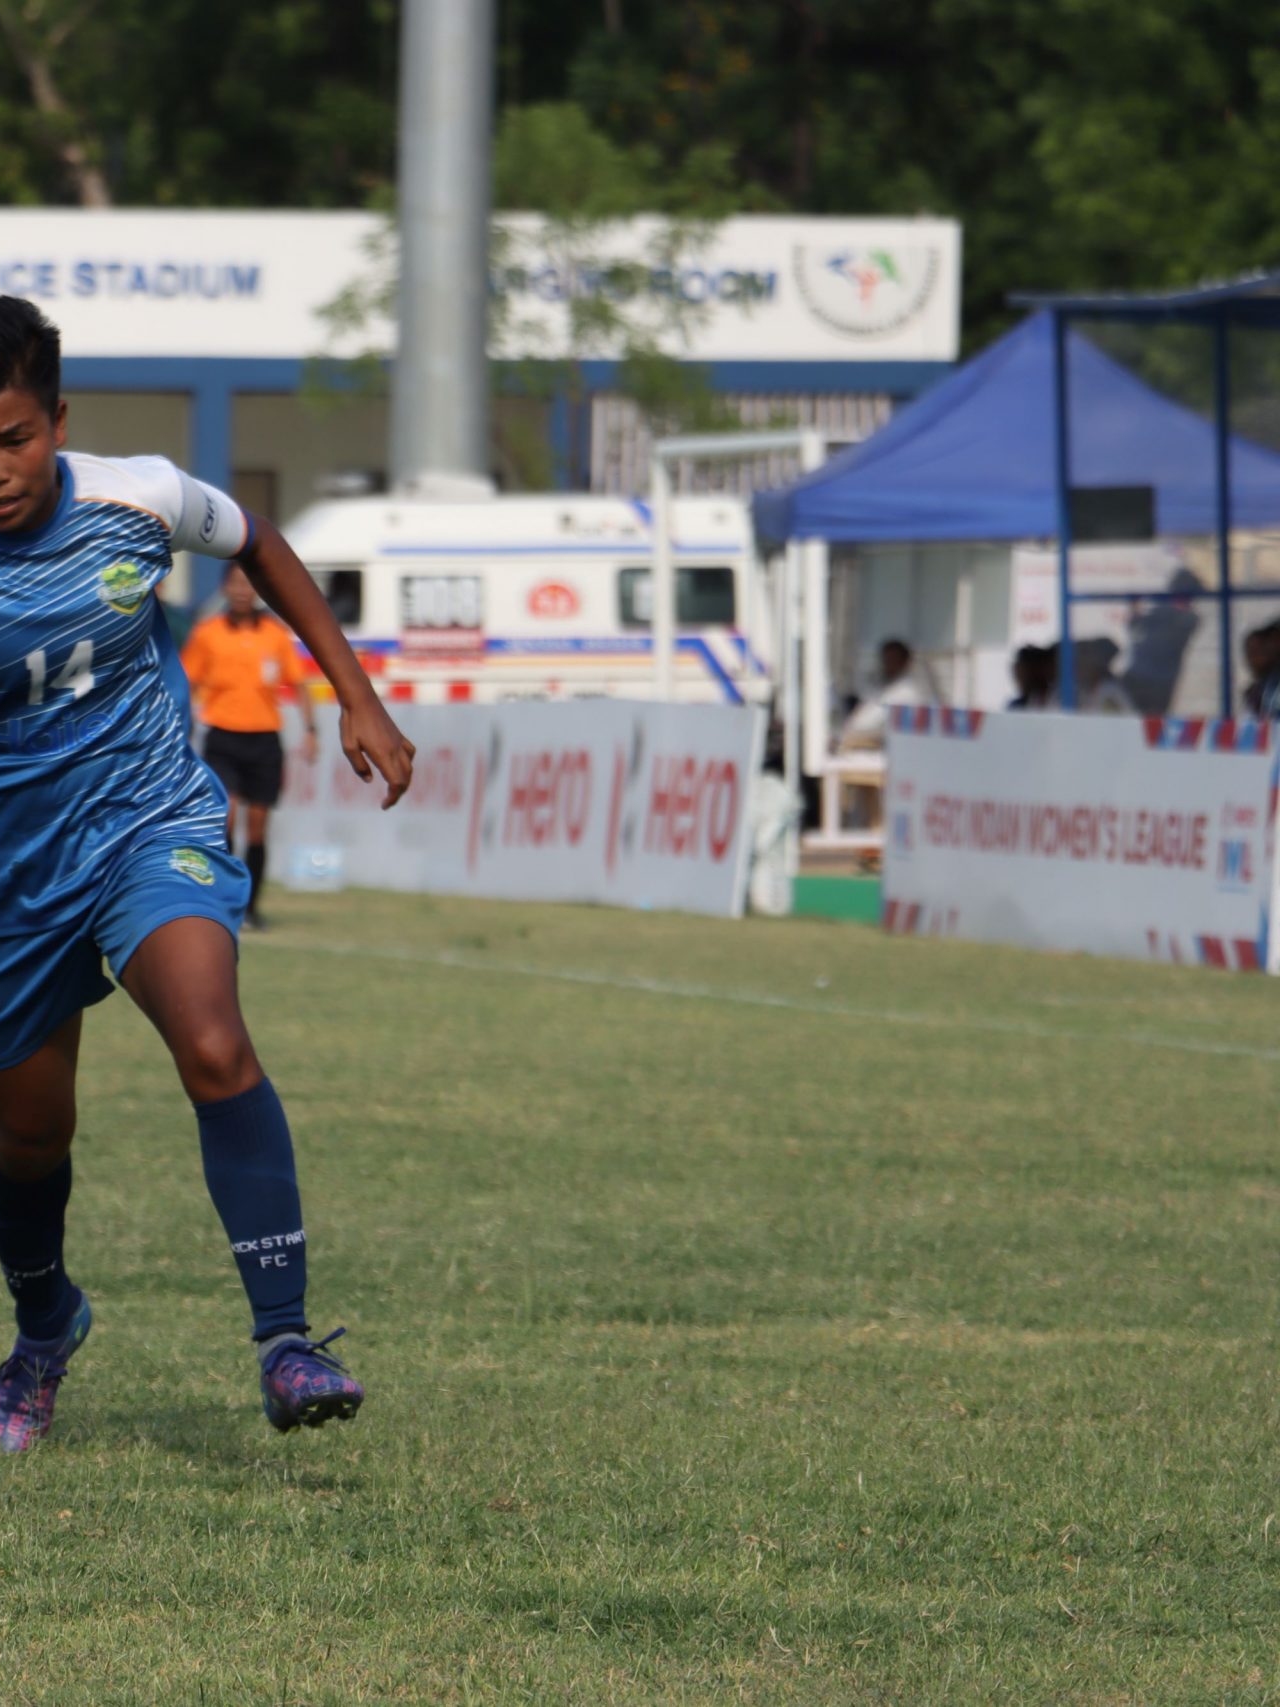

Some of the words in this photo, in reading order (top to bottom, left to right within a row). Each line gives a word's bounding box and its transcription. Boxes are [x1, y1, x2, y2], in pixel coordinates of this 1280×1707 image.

[70, 258, 262, 299] STADIUM
[25, 639, 96, 706] 14
[1122, 808, 1210, 871] LEAGUE
[259, 1253, 288, 1269] FC
